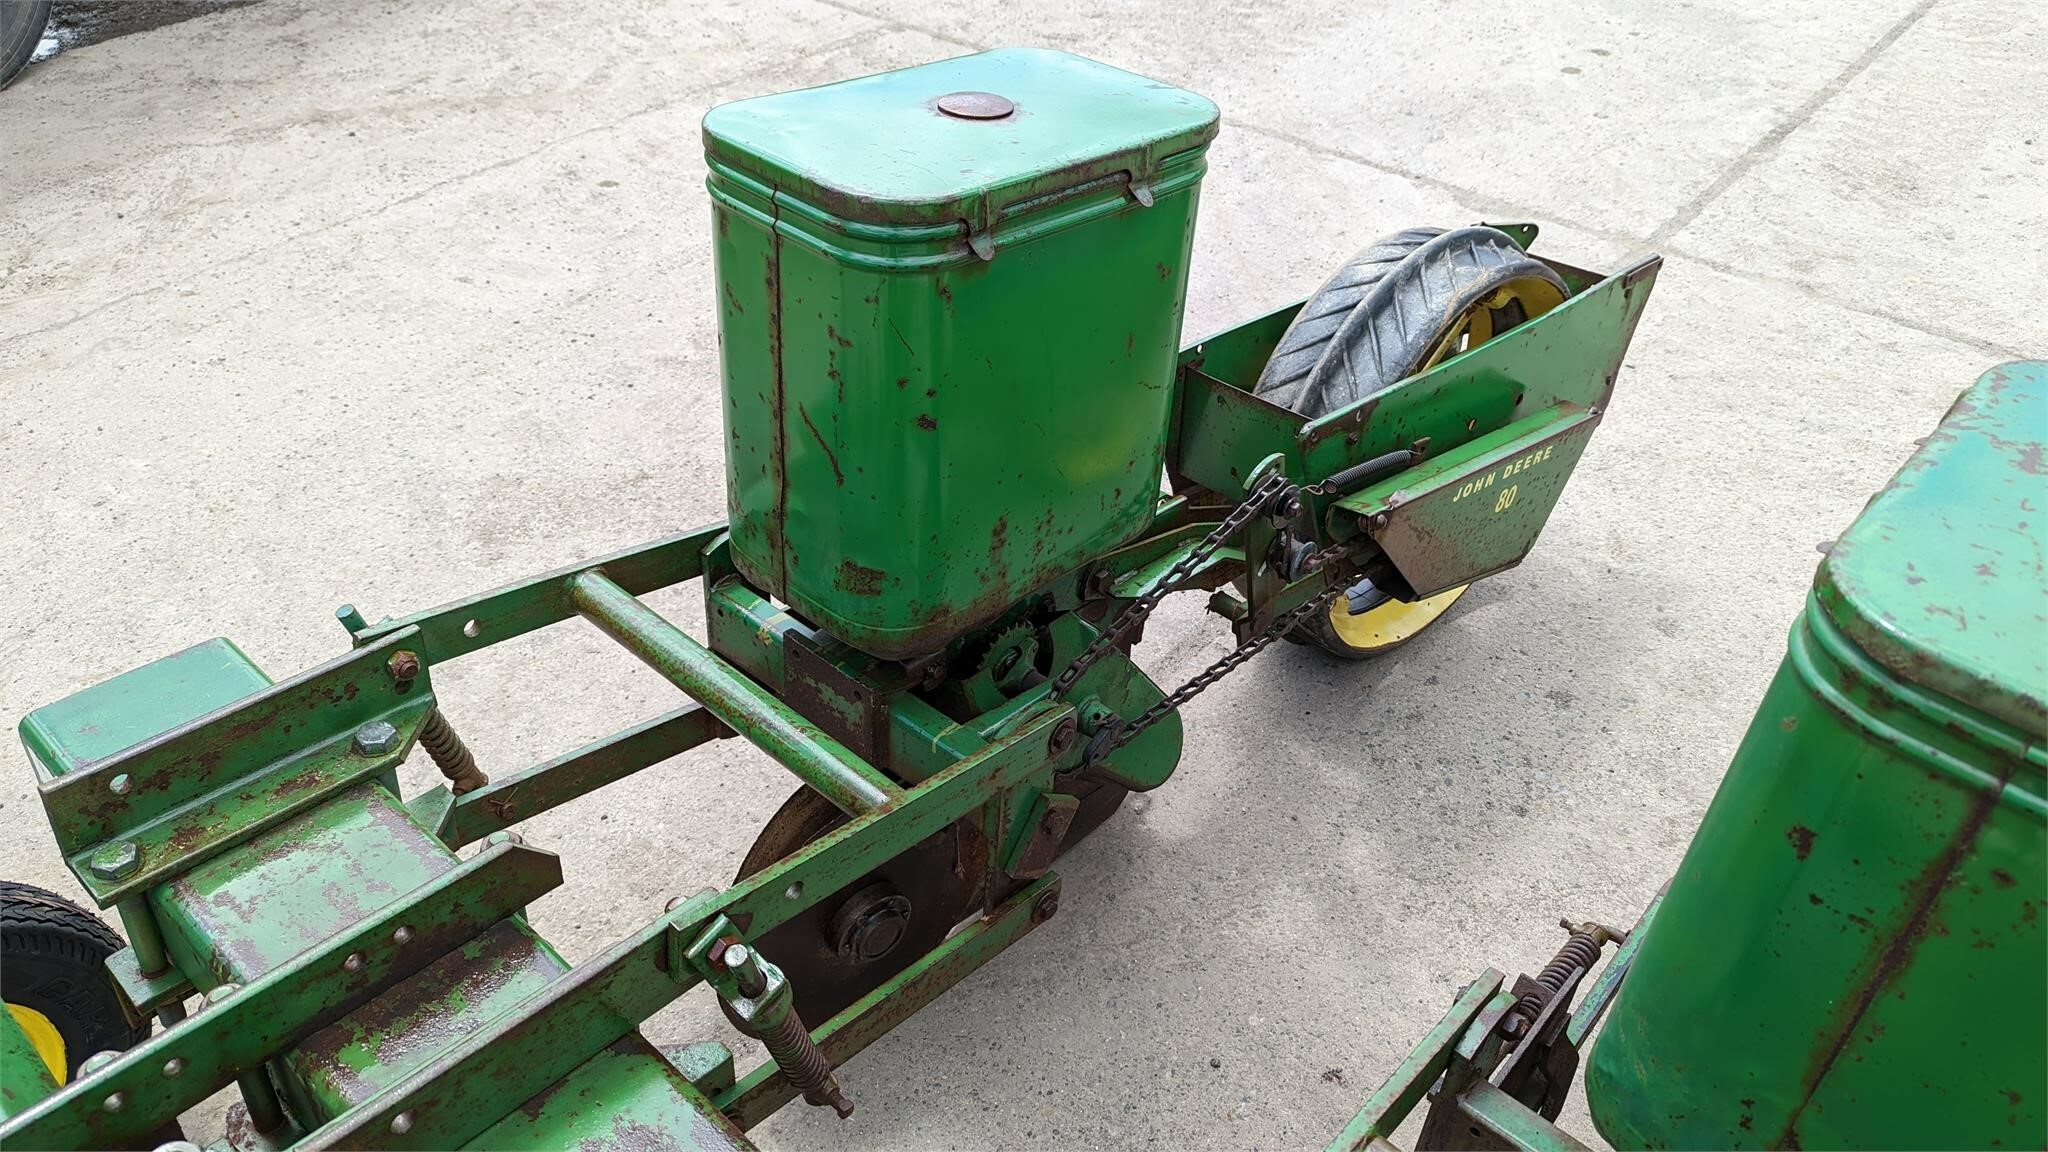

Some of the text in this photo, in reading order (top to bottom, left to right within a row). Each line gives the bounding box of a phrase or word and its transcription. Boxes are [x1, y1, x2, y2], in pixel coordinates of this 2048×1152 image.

[1452, 446, 1553, 502] JOHN DEERE
[1494, 484, 1518, 513] 80
